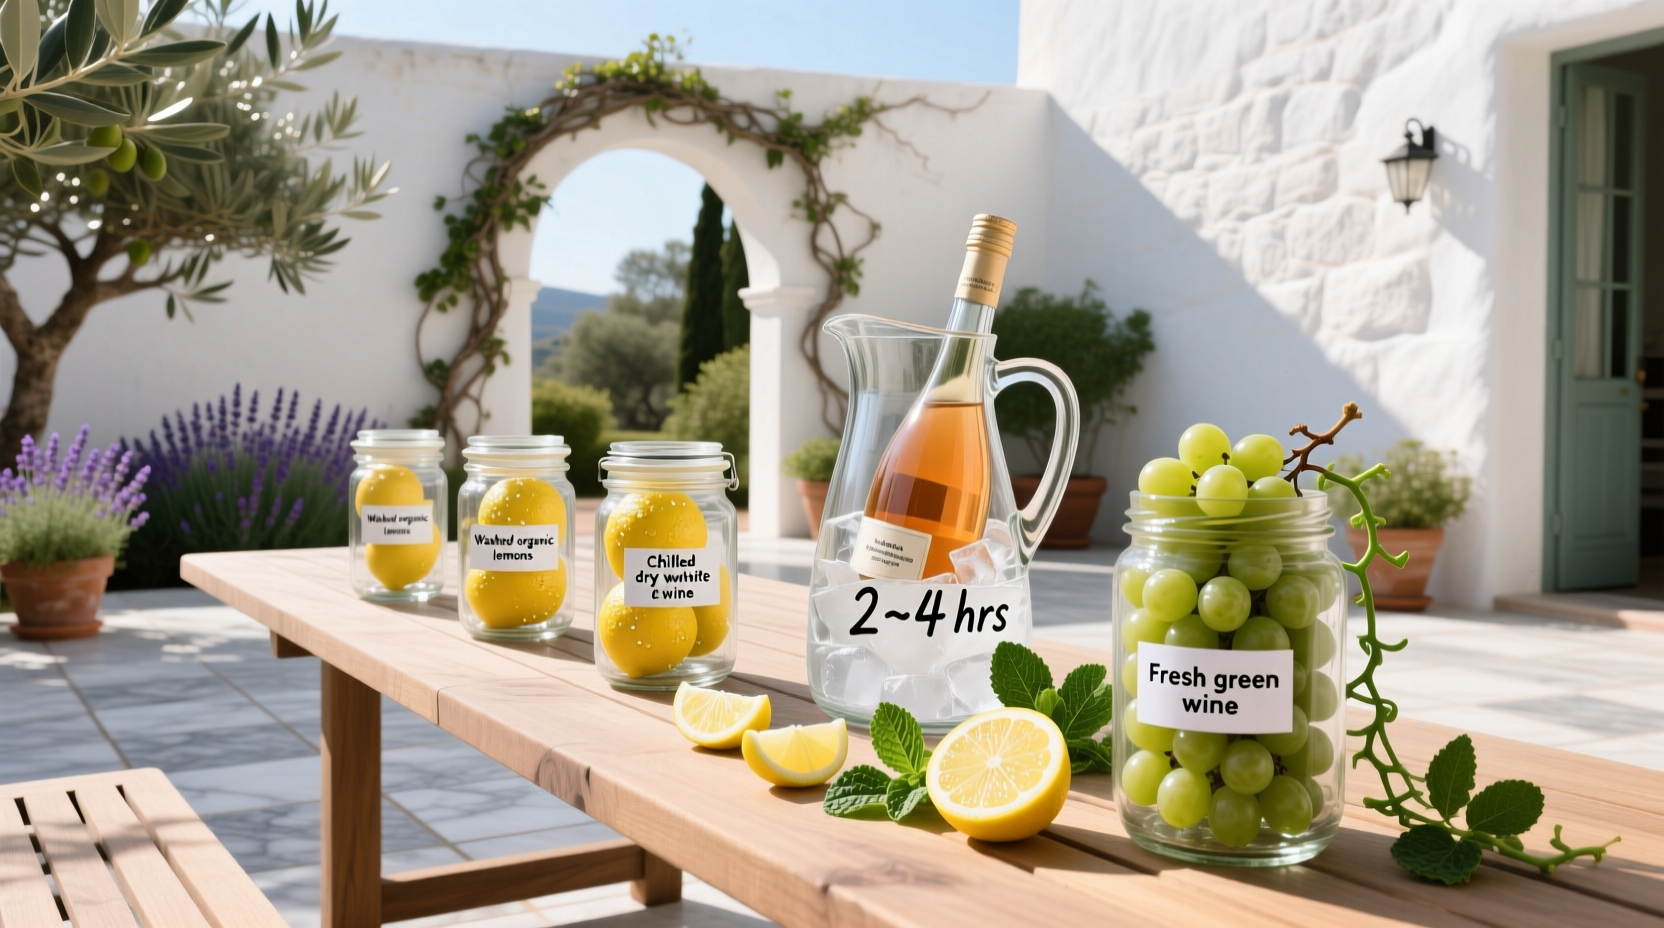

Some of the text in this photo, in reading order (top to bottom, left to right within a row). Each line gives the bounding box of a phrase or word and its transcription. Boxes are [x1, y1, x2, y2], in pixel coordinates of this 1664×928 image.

[493, 549, 533, 561] lemons
[647, 554, 696, 568] Chilled
[635, 570, 659, 587] dry
[662, 587, 694, 599] wine
[953, 588, 1009, 634] hrs
[1150, 662, 1279, 694] Fresh green
[1182, 694, 1239, 715] wine
